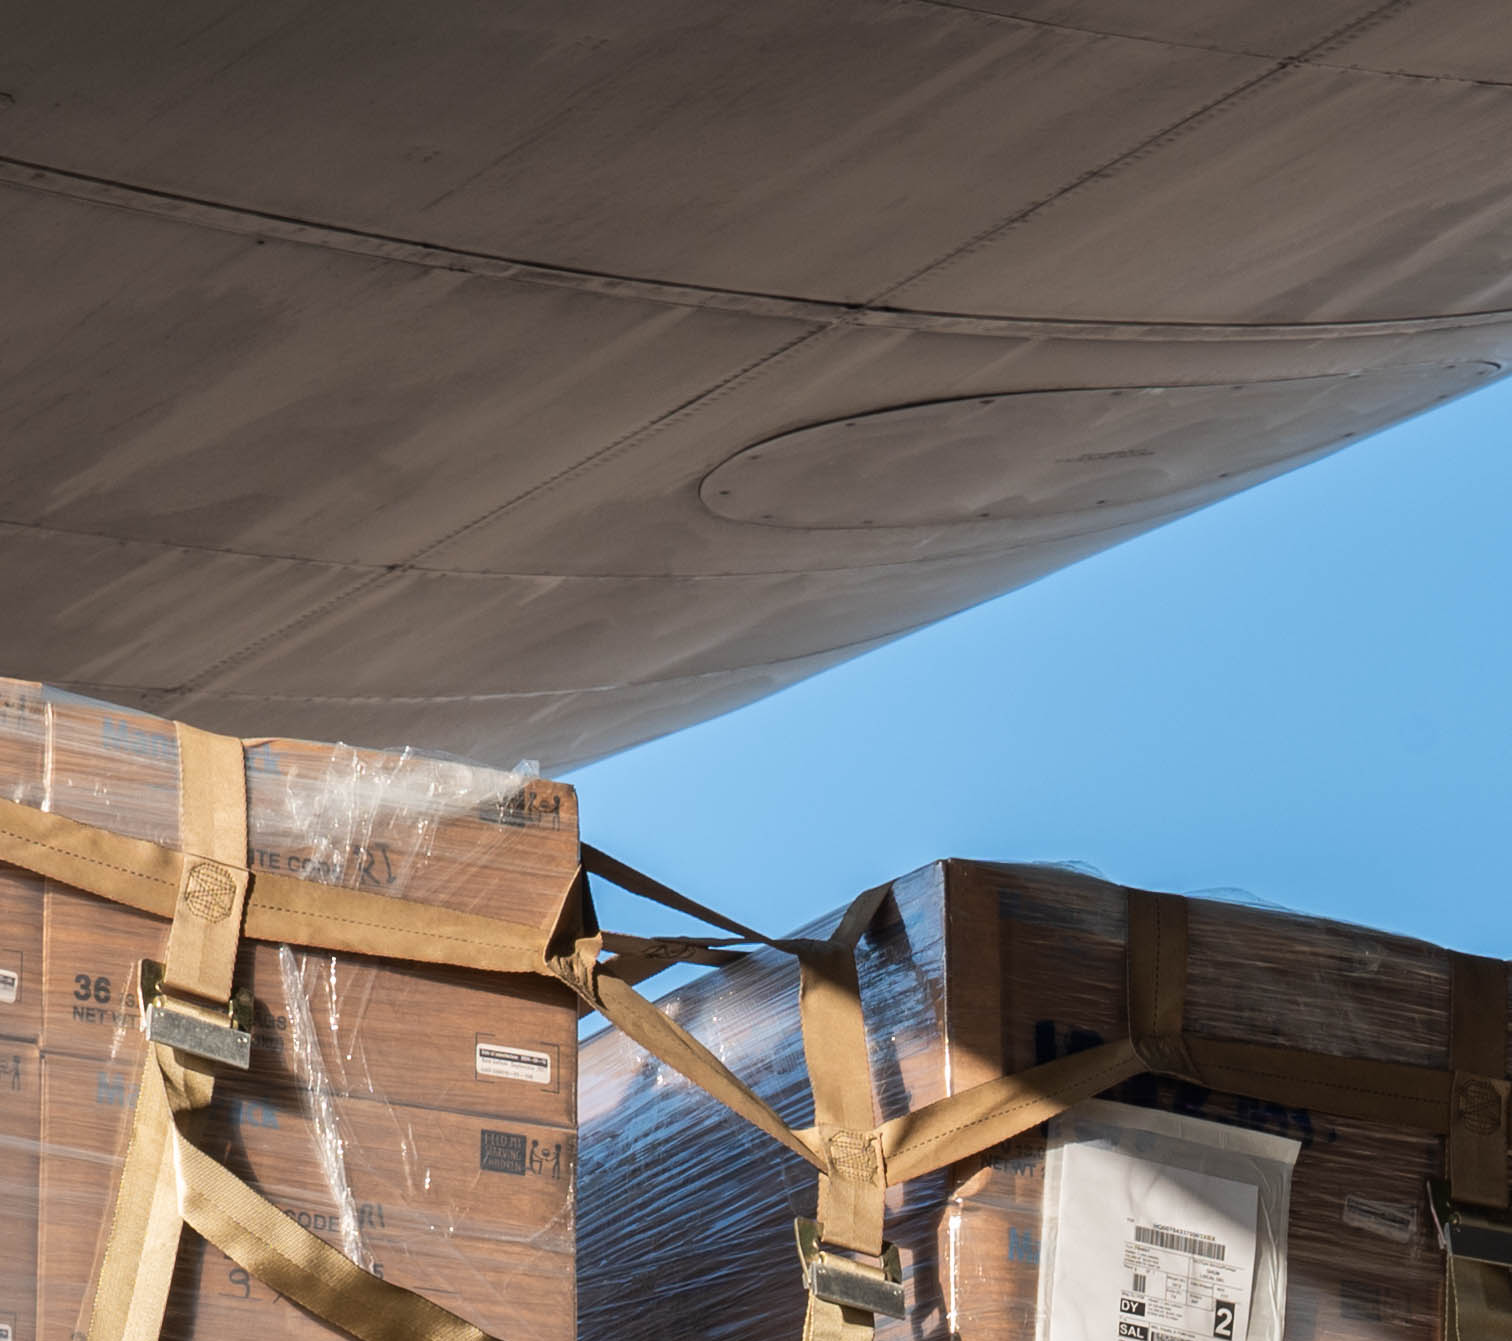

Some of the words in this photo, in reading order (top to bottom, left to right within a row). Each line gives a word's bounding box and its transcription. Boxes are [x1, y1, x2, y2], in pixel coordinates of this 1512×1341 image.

[74, 974, 111, 1004] 36
[1121, 1300, 1140, 1314] DY
[1119, 1324, 1145, 1340] SAL
[1216, 1307, 1233, 1337] 2
